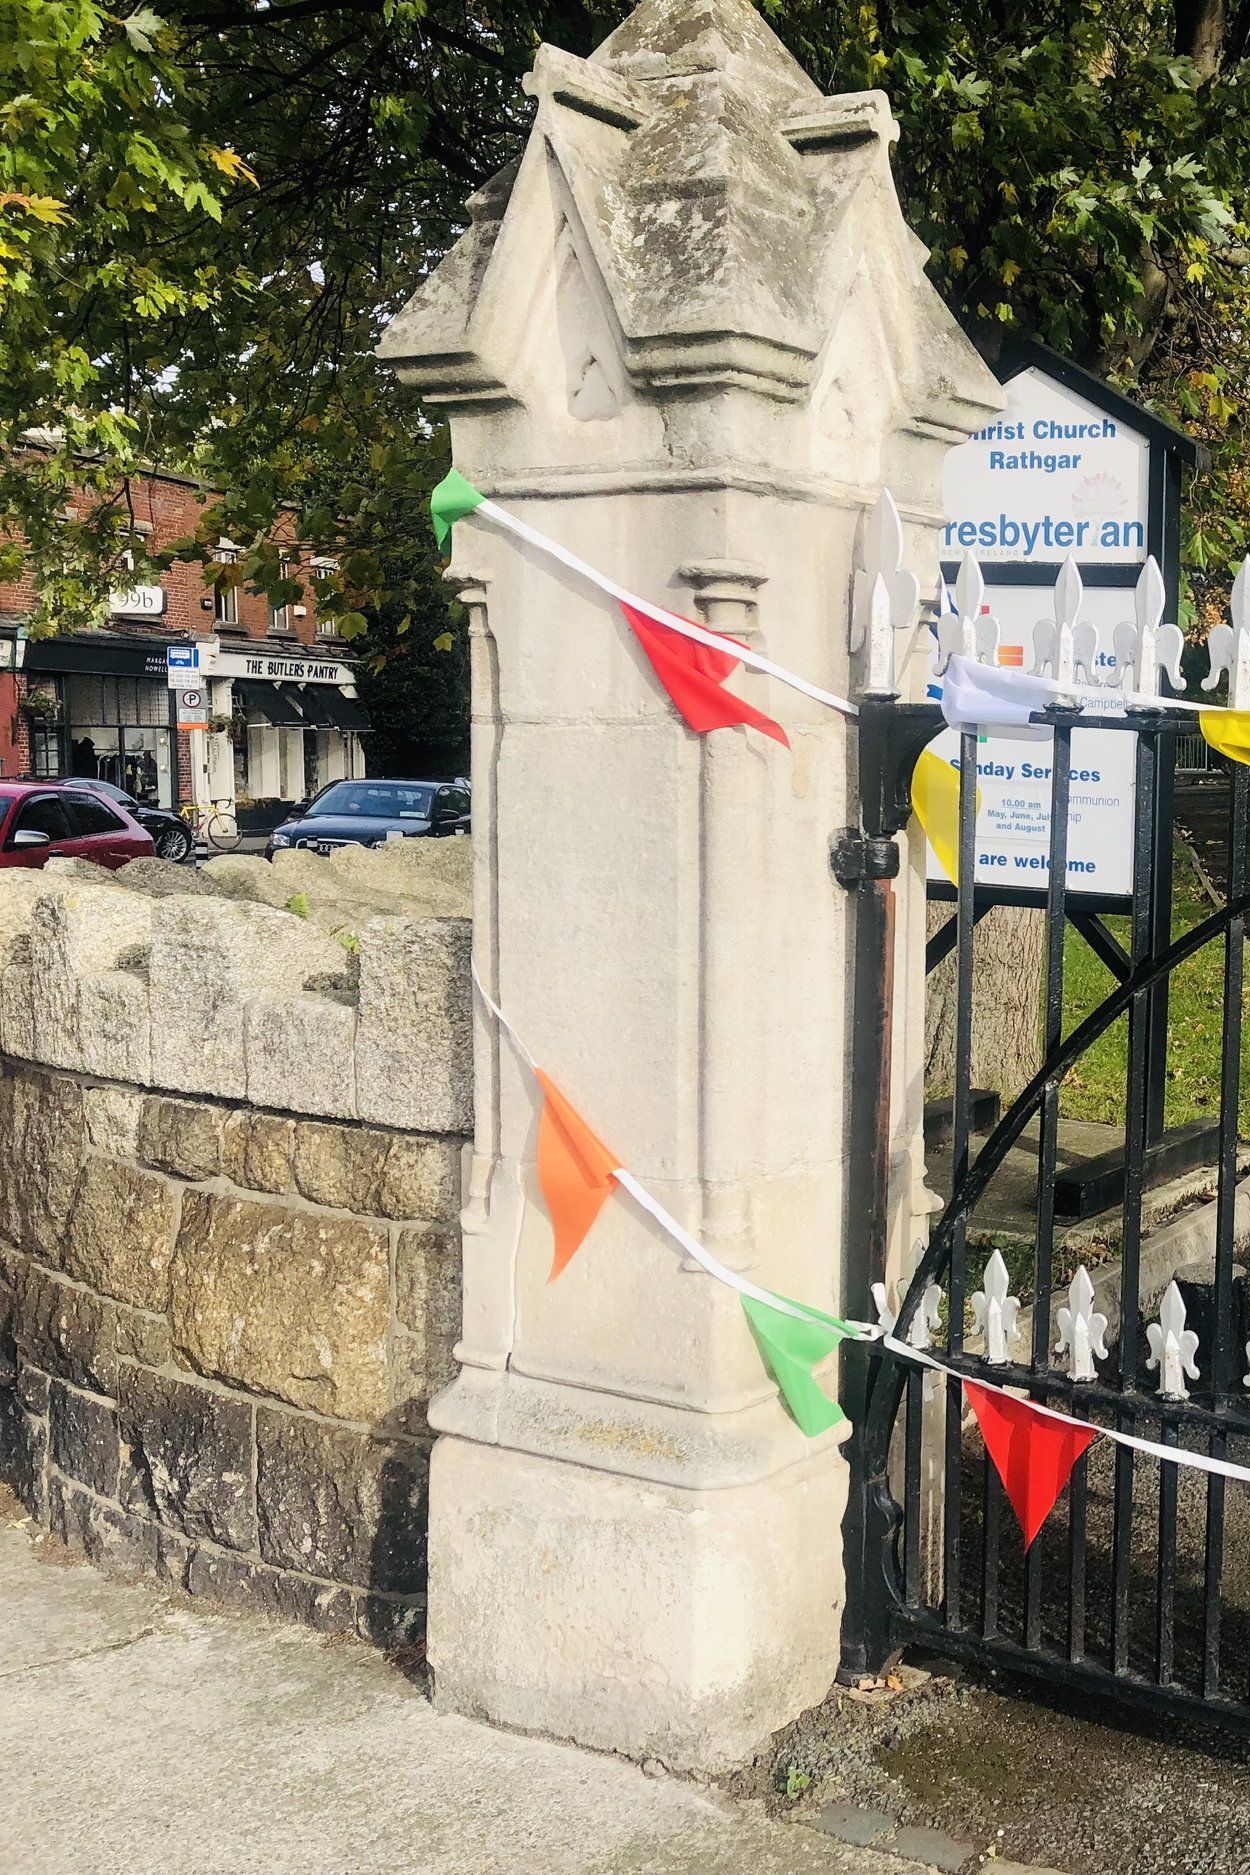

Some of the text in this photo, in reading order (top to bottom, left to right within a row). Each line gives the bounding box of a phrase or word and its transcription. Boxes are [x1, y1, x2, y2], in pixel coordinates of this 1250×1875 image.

[1033, 418, 1116, 440] Church
[990, 450, 1082, 473] Rathgar
[246, 660, 339, 680] THE BUTLER'S PANTRY
[950, 758, 1101, 782] Snday Serces
[1001, 799, 1042, 809] 10.00 am
[1067, 794, 1120, 808] ommunion
[987, 809, 1008, 820] May,
[1010, 811, 1034, 822] June,
[995, 823, 1046, 834] and August
[979, 853, 1007, 866] are
